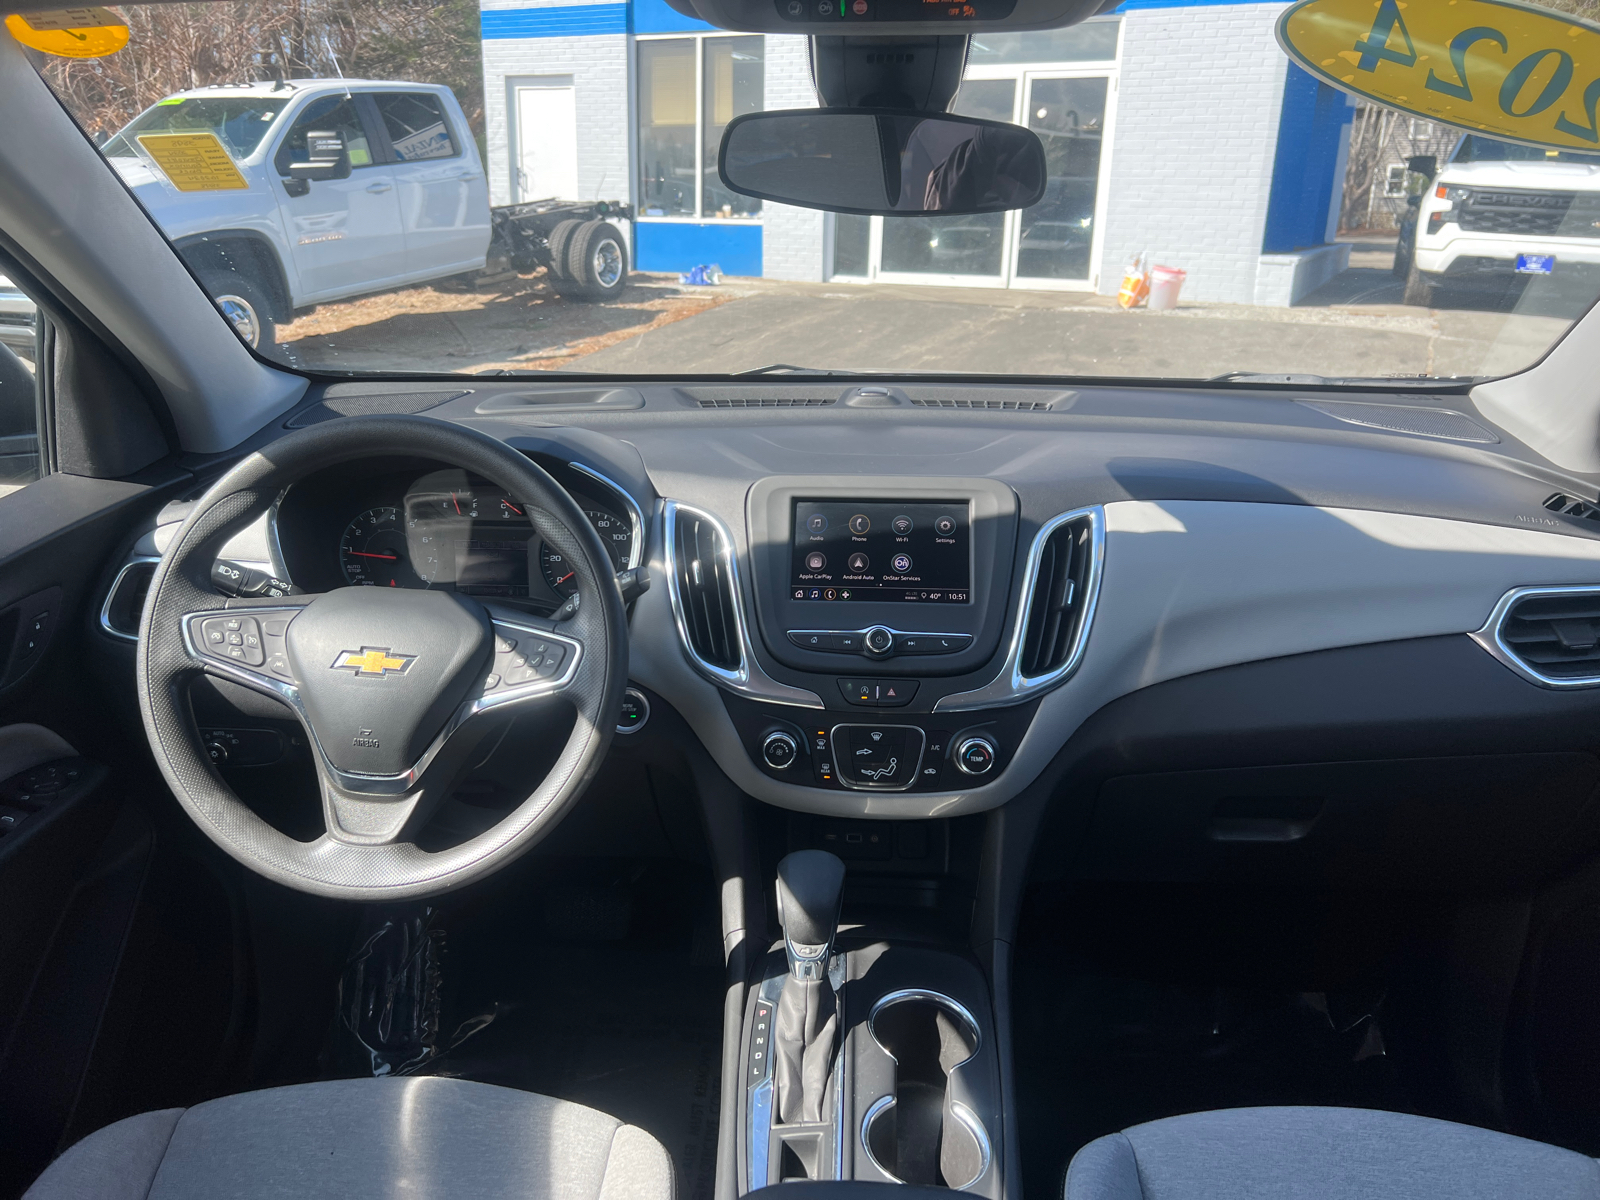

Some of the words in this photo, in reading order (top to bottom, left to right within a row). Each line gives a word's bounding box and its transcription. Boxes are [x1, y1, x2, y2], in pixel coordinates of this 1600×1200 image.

[948, 8, 960, 16] OFF
[597, 520, 610, 528] 80
[612, 533, 627, 541] 100
[352, 737, 380, 749] AIRBAG
[969, 755, 984, 763] TEMP
[759, 1009, 767, 1017] P
[756, 1037, 764, 1045] N
[753, 1067, 760, 1075] L
